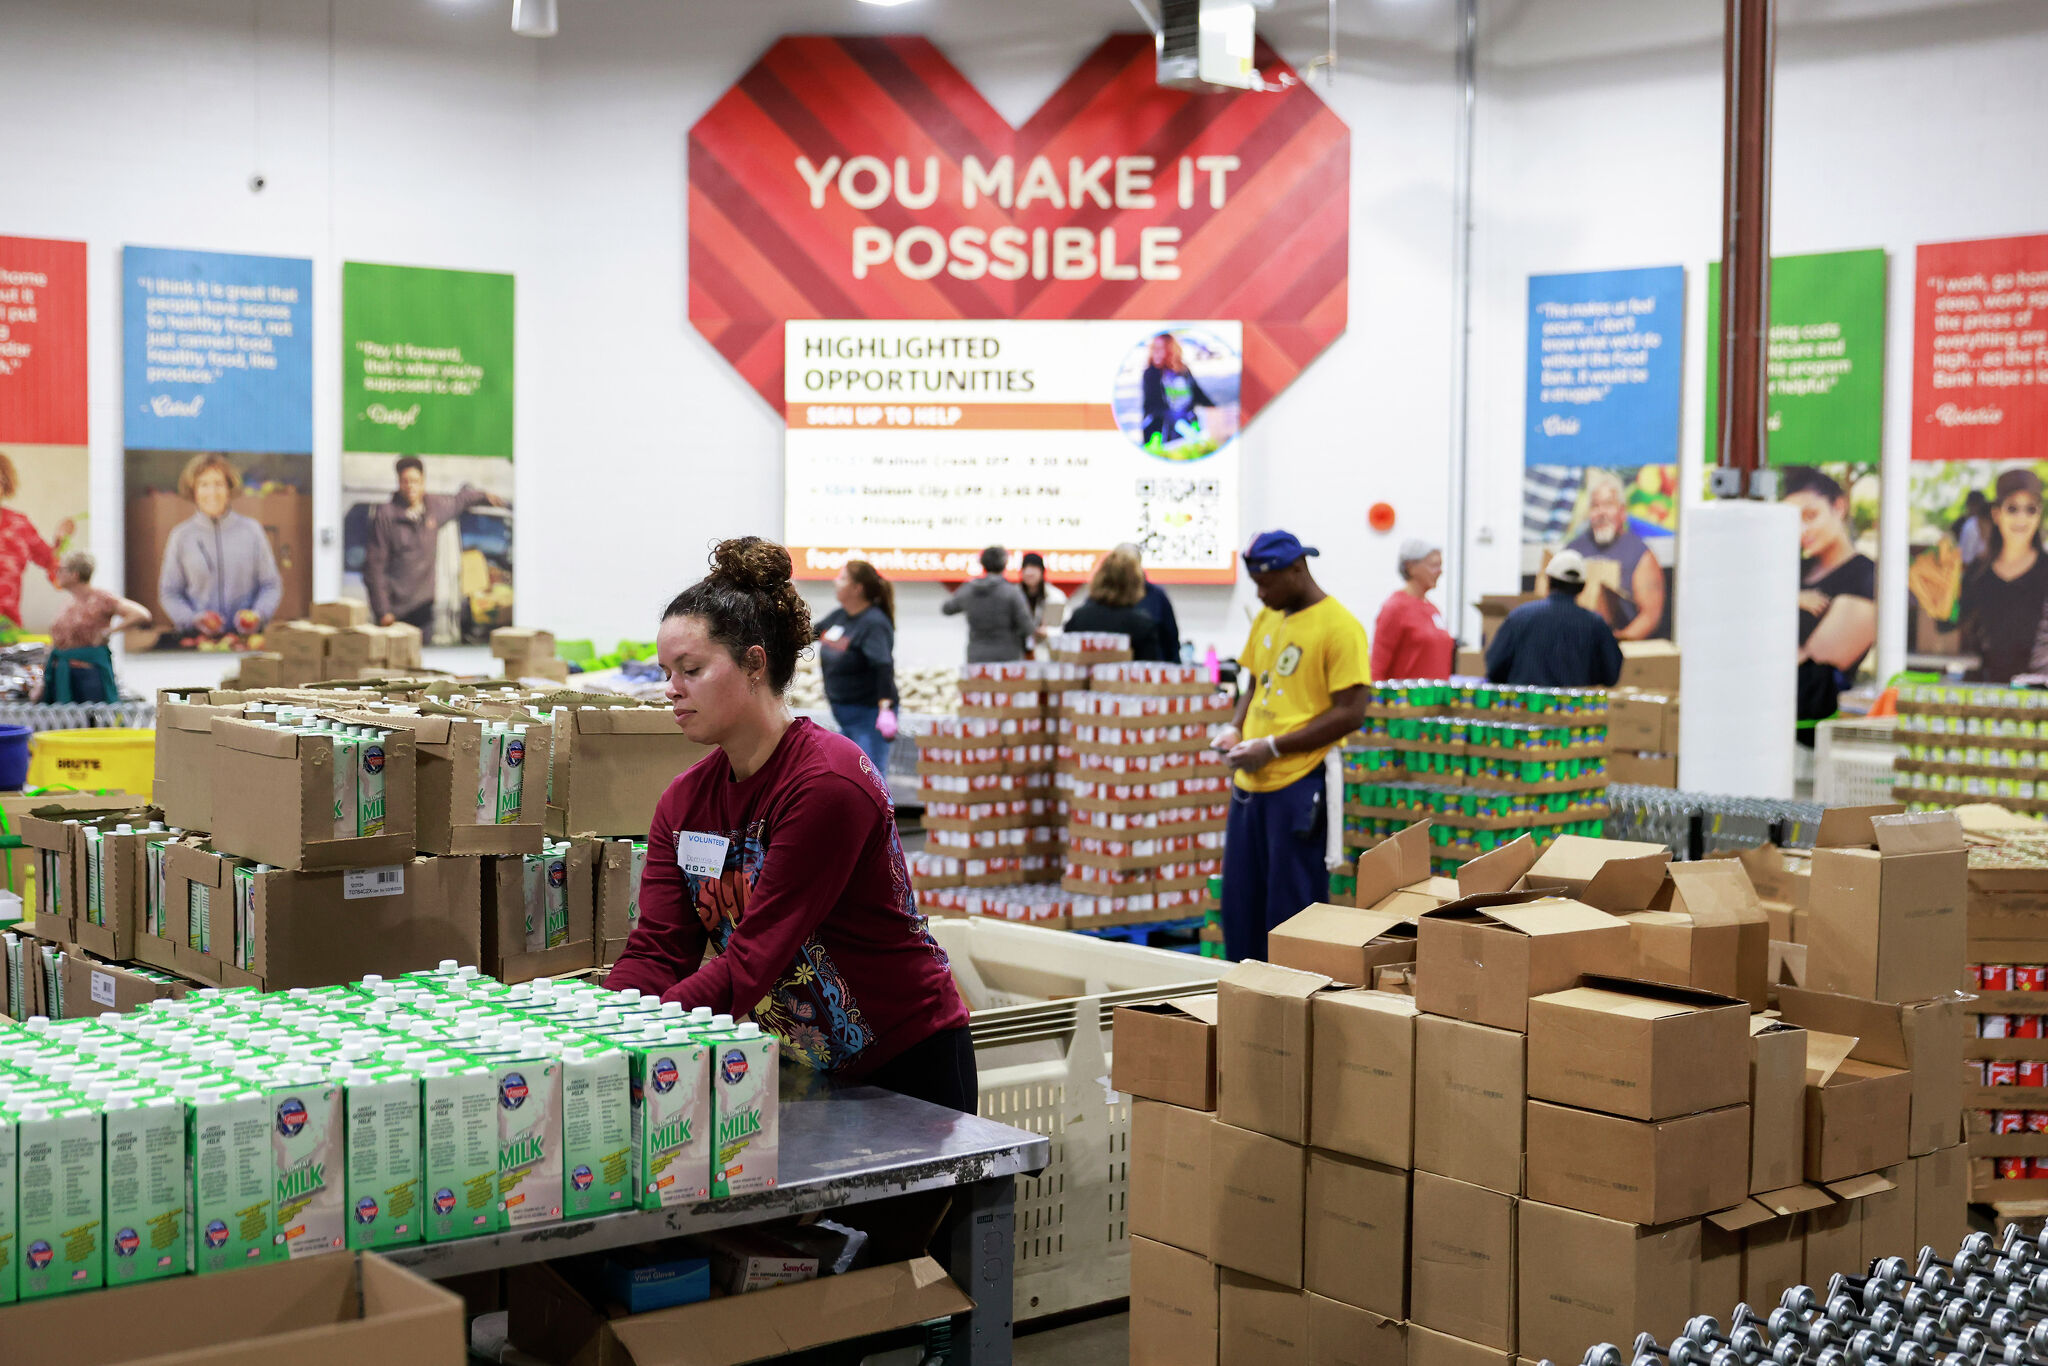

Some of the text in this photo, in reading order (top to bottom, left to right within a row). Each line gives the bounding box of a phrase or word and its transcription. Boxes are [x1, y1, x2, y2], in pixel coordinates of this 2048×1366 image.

[794, 155, 1241, 209] YOU MAKE IT
[851, 226, 1182, 280] POSSIBLE
[156, 277, 195, 296] think
[226, 283, 266, 302] great
[268, 285, 298, 303] that
[1991, 272, 2015, 293] go
[147, 298, 291, 320] people have access
[1570, 301, 1611, 317] makes
[1982, 291, 2024, 309] work
[147, 313, 166, 330] to
[167, 314, 224, 335] healthy
[266, 321, 293, 337] not
[1801, 322, 1841, 339] costs
[1934, 308, 2033, 332] the prices of
[147, 329, 176, 348] just
[178, 333, 234, 350] canned
[805, 337, 1001, 359] HIGHLIGHTED
[1541, 337, 1576, 352] know
[1576, 335, 1608, 351] what
[1815, 337, 1847, 357] and
[1934, 329, 2047, 352] everything are
[147, 349, 206, 369] Healthy
[250, 353, 278, 370] like
[405, 360, 439, 377] what
[1541, 353, 1588, 368] without
[1589, 351, 1611, 367] the
[1788, 358, 1853, 379] program
[2005, 350, 2033, 367] the
[363, 375, 432, 393] supposed
[433, 379, 449, 394] to
[805, 369, 1035, 391] OPPORTUNITIES
[1590, 368, 1628, 384] would
[1628, 367, 1649, 383] be
[1933, 370, 1974, 388] Bank
[1976, 368, 2020, 388] helps
[806, 406, 962, 425] SIGN UP TO HELP
[688, 834, 725, 847] VOLUNTEER
[650, 1118, 691, 1154] MILK
[719, 1109, 760, 1144] MILK
[499, 1135, 543, 1173] MILK
[277, 1162, 324, 1204] MILK
